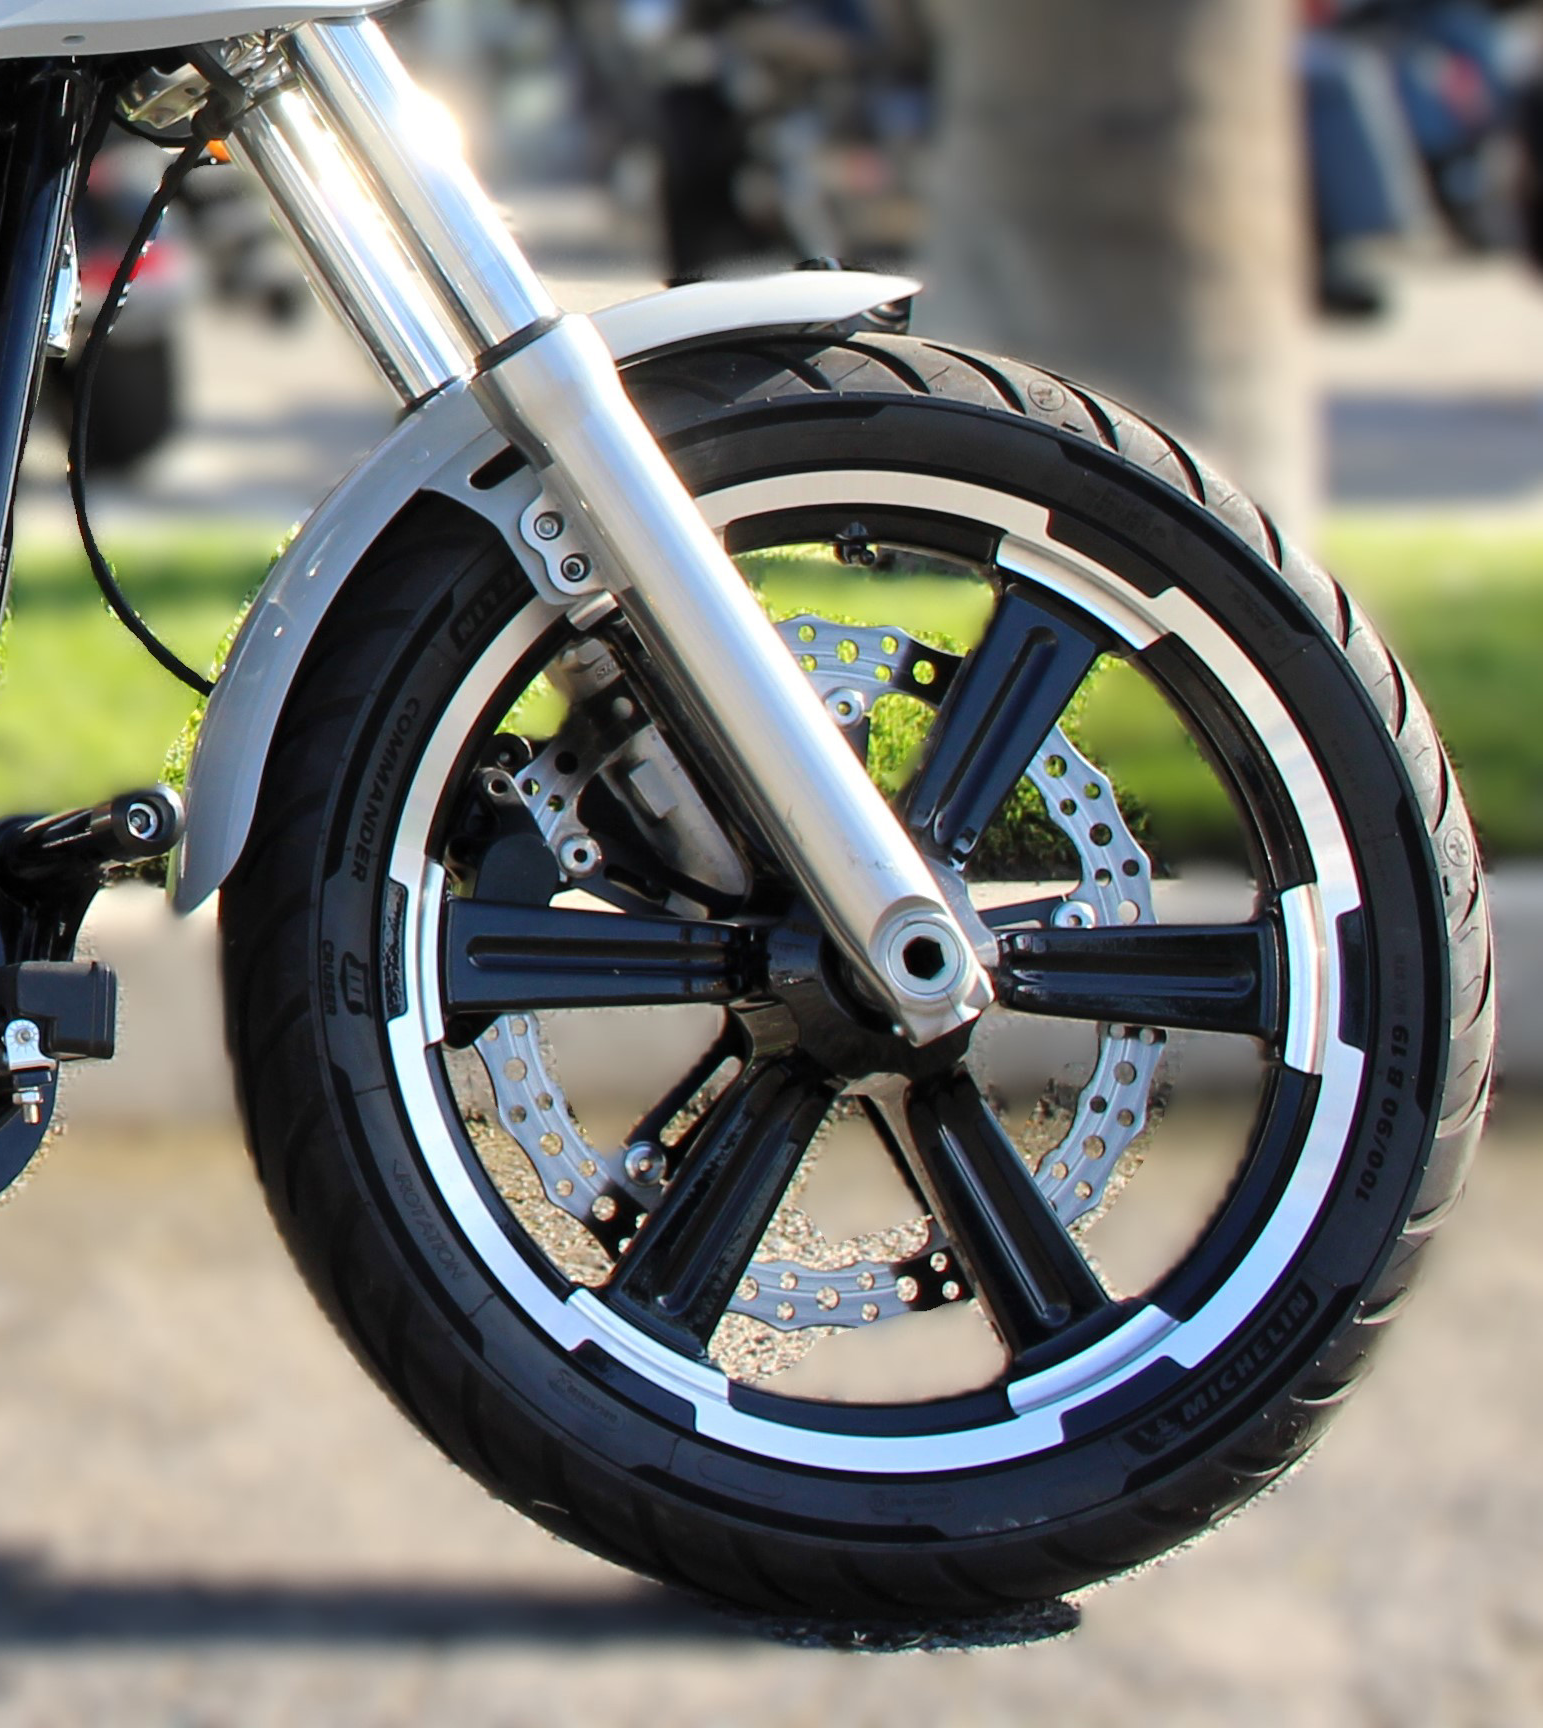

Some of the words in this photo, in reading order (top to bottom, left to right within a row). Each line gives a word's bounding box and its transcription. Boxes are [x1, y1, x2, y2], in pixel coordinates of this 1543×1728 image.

[350, 696, 421, 883] COMMANDER
[321, 938, 337, 1016] CRUISER
[1387, 1065, 1405, 1087] B
[1391, 1023, 1410, 1056] 19
[1355, 1098, 1400, 1203] 100/90
[395, 1178, 468, 1280] ROTATION
[1182, 1290, 1312, 1424] MICHELIN
